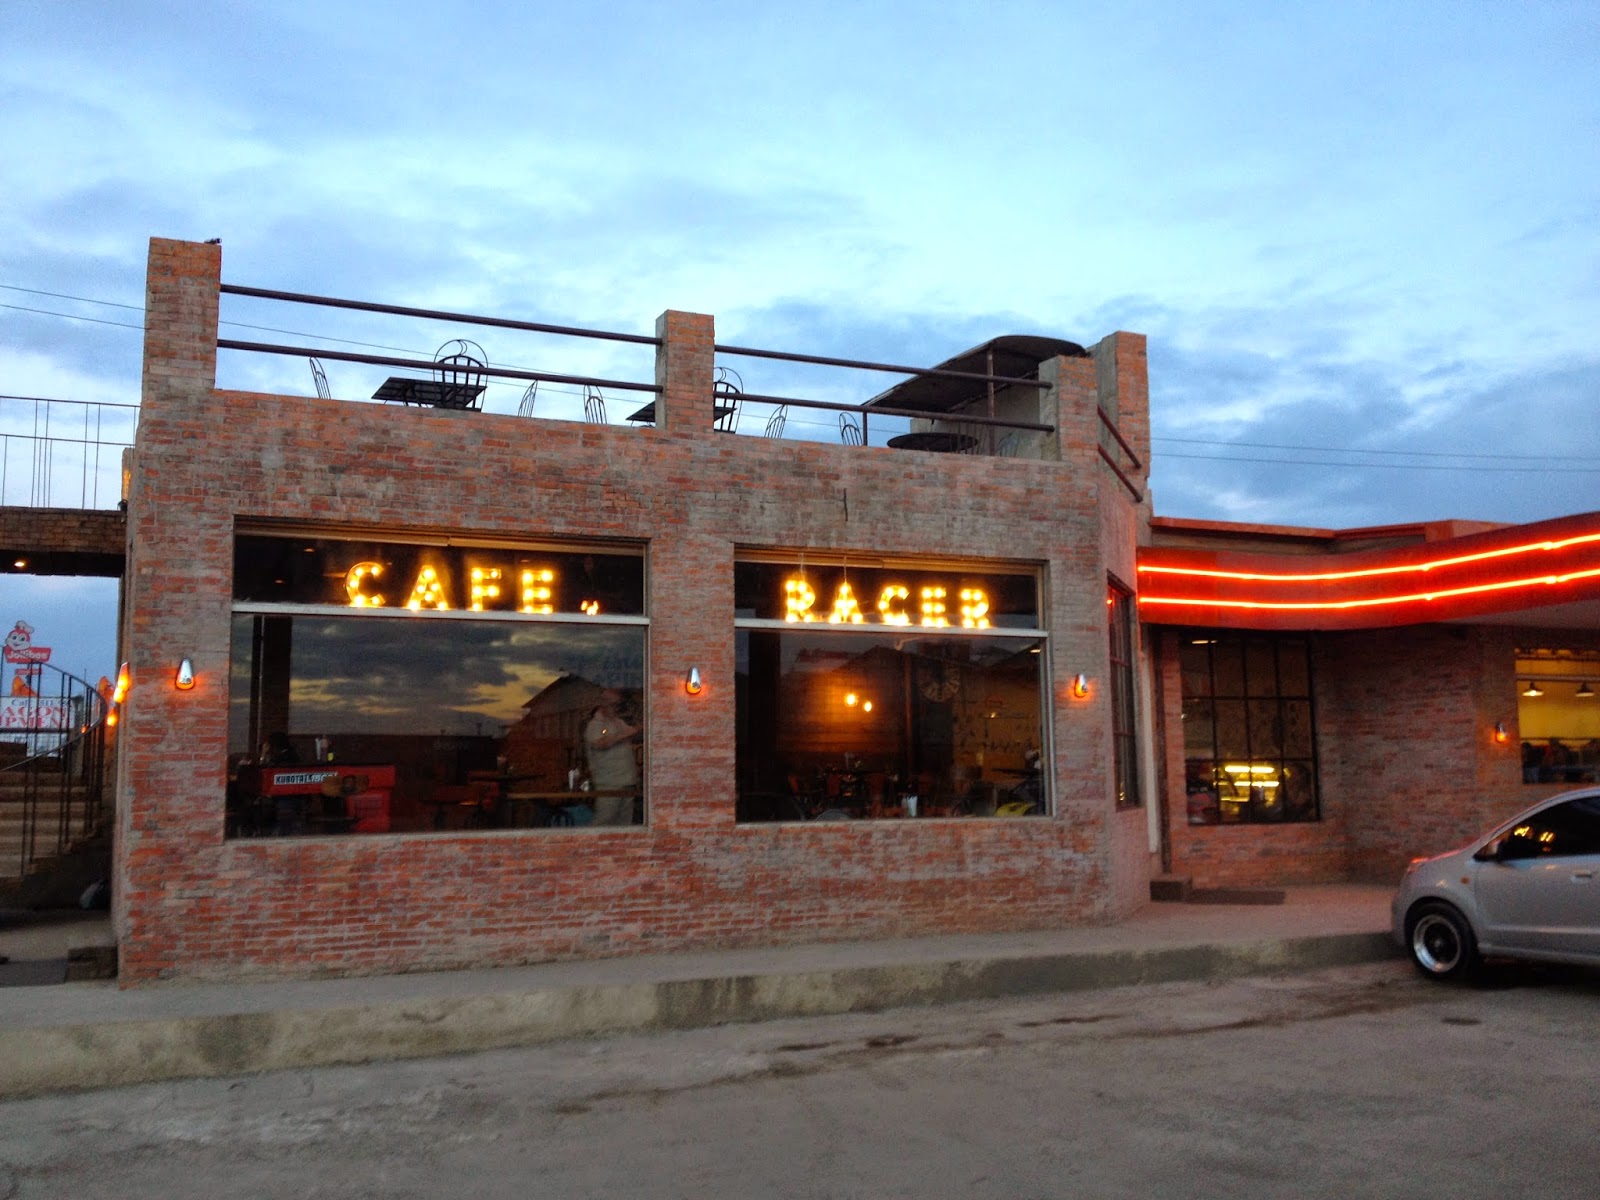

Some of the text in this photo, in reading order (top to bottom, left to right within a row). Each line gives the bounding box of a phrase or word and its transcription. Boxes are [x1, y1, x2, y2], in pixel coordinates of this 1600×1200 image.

[346, 561, 554, 614] CAFE
[785, 575, 991, 629] RACER
[8, 650, 48, 659] Jollibee
[275, 774, 304, 784] KUBOTA
